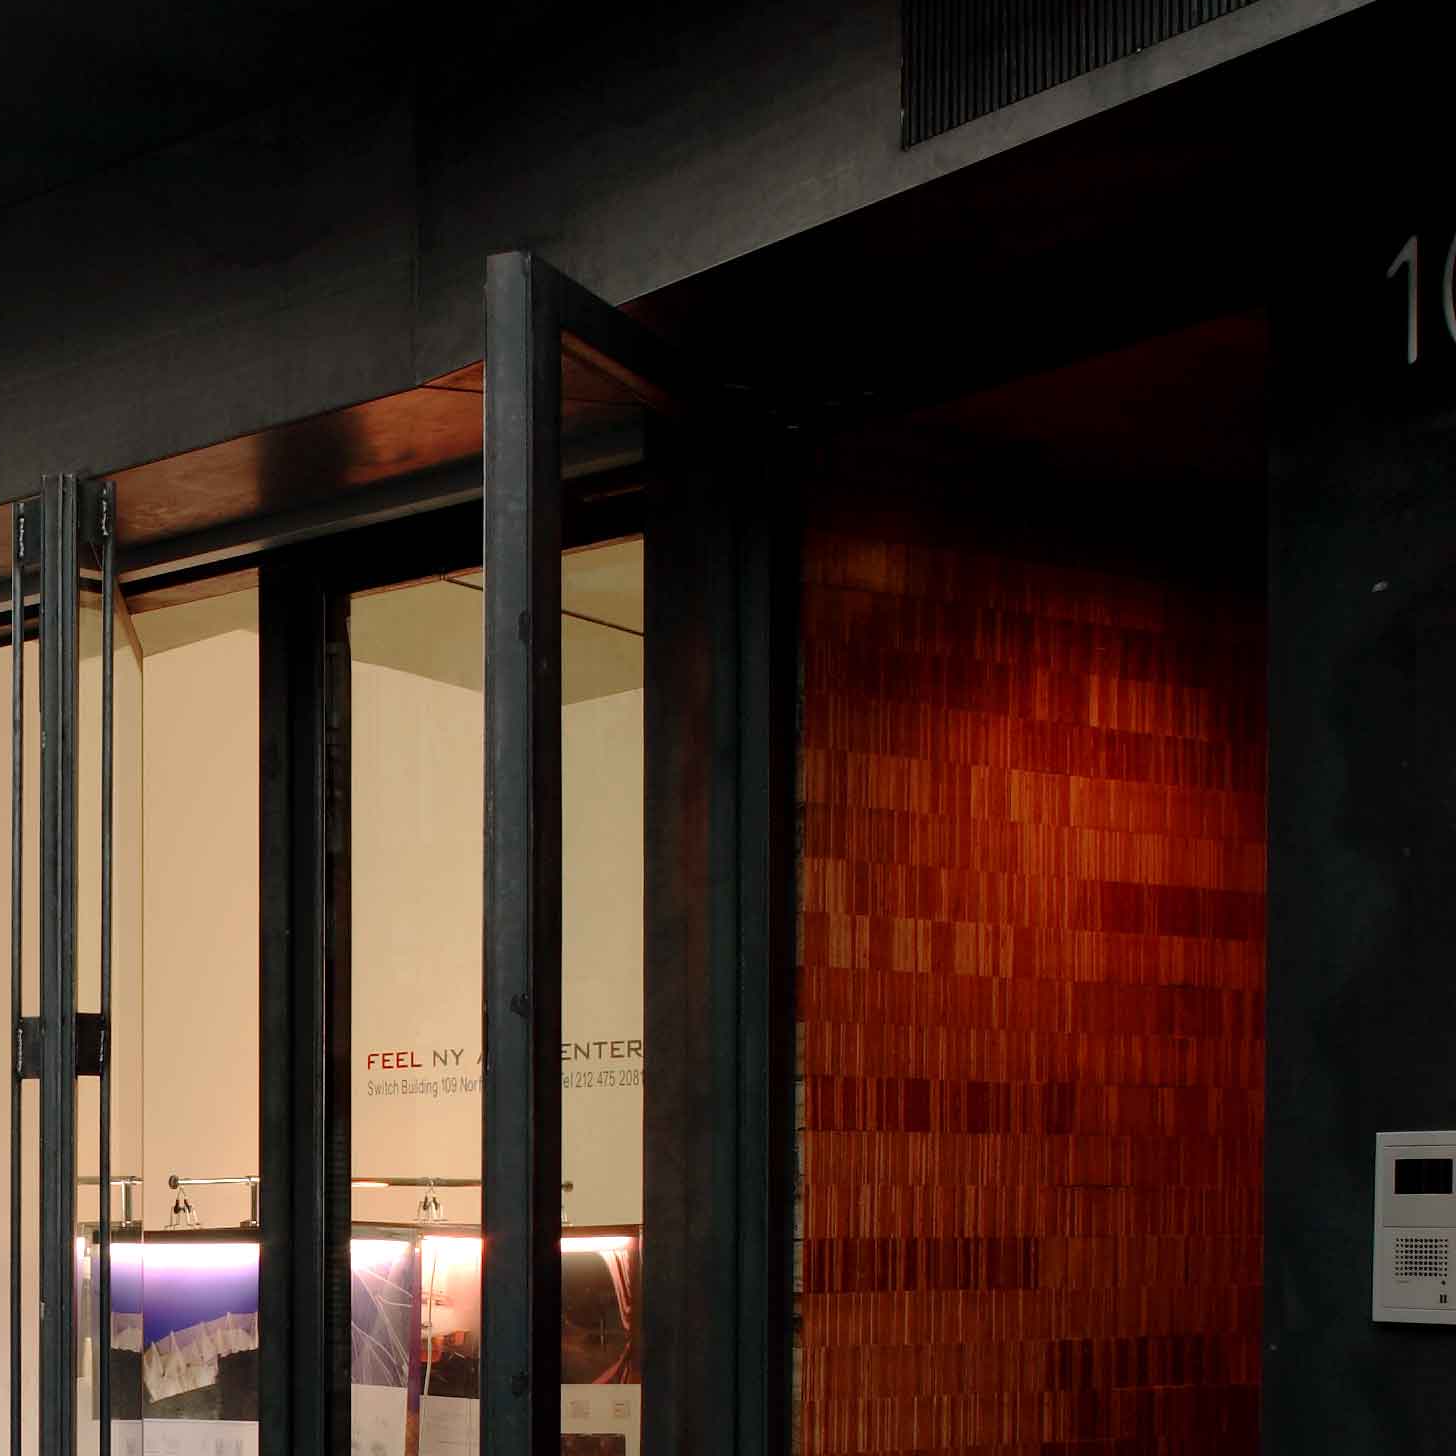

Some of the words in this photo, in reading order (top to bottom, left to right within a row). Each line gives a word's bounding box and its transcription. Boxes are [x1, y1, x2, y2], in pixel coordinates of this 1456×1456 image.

[1385, 234, 1456, 365] 1
[367, 1051, 423, 1071] FEEL
[432, 1048, 464, 1067] NY
[561, 1039, 644, 1061] ENTER
[367, 1079, 399, 1096] Switch
[401, 1079, 438, 1098] Building
[561, 1071, 573, 1089] el
[575, 1071, 593, 1088] 212
